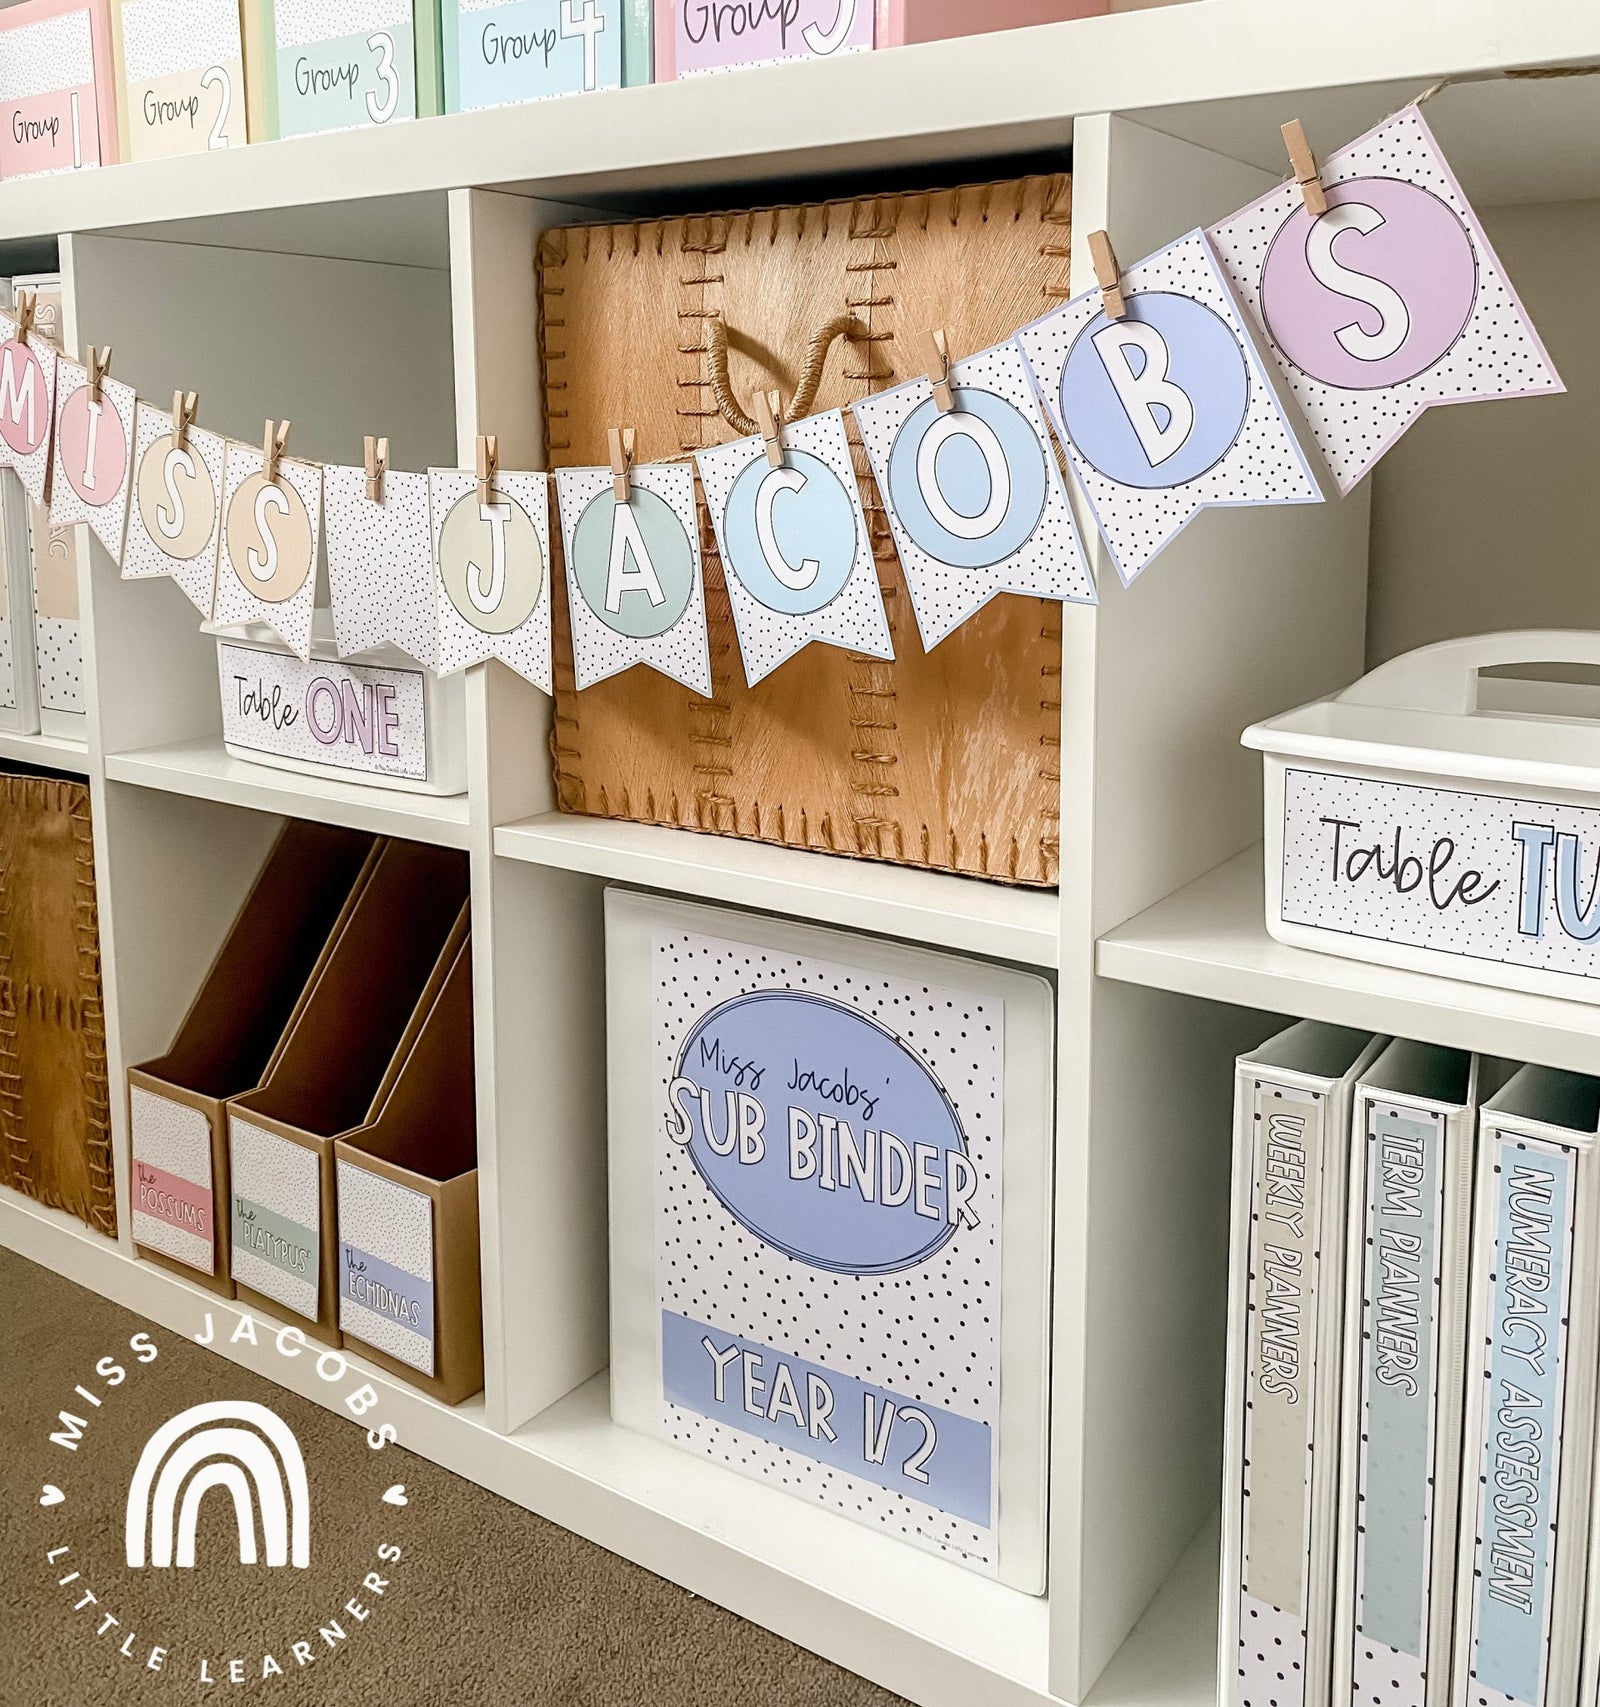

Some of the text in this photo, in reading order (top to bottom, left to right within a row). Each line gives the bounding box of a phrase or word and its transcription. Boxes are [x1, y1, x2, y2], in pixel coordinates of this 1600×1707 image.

[295, 31, 399, 124] Group 3
[482, 0, 605, 91] Group 4
[13, 92, 82, 169] Group 1
[143, 65, 232, 150] Group 2
[233, 675, 399, 757] Table ONE
[1319, 817, 1500, 910] Table
[700, 1036, 889, 1120] Miss Jacobs'
[137, 1163, 157, 1185] the
[666, 1076, 981, 1229] SUB BINDER
[140, 1185, 207, 1232] POSSUMS
[237, 1199, 257, 1222] the
[345, 1248, 367, 1272] the
[349, 1271, 422, 1328] ECHIDNAS
[1260, 1112, 1306, 1405] WEEKLY PLANNERS
[1375, 1132, 1425, 1397] TERM PLANNERS
[701, 1336, 937, 1485] YEAR 1/2
[1488, 1164, 1556, 1616] NUMERACY ASSESSMENT
